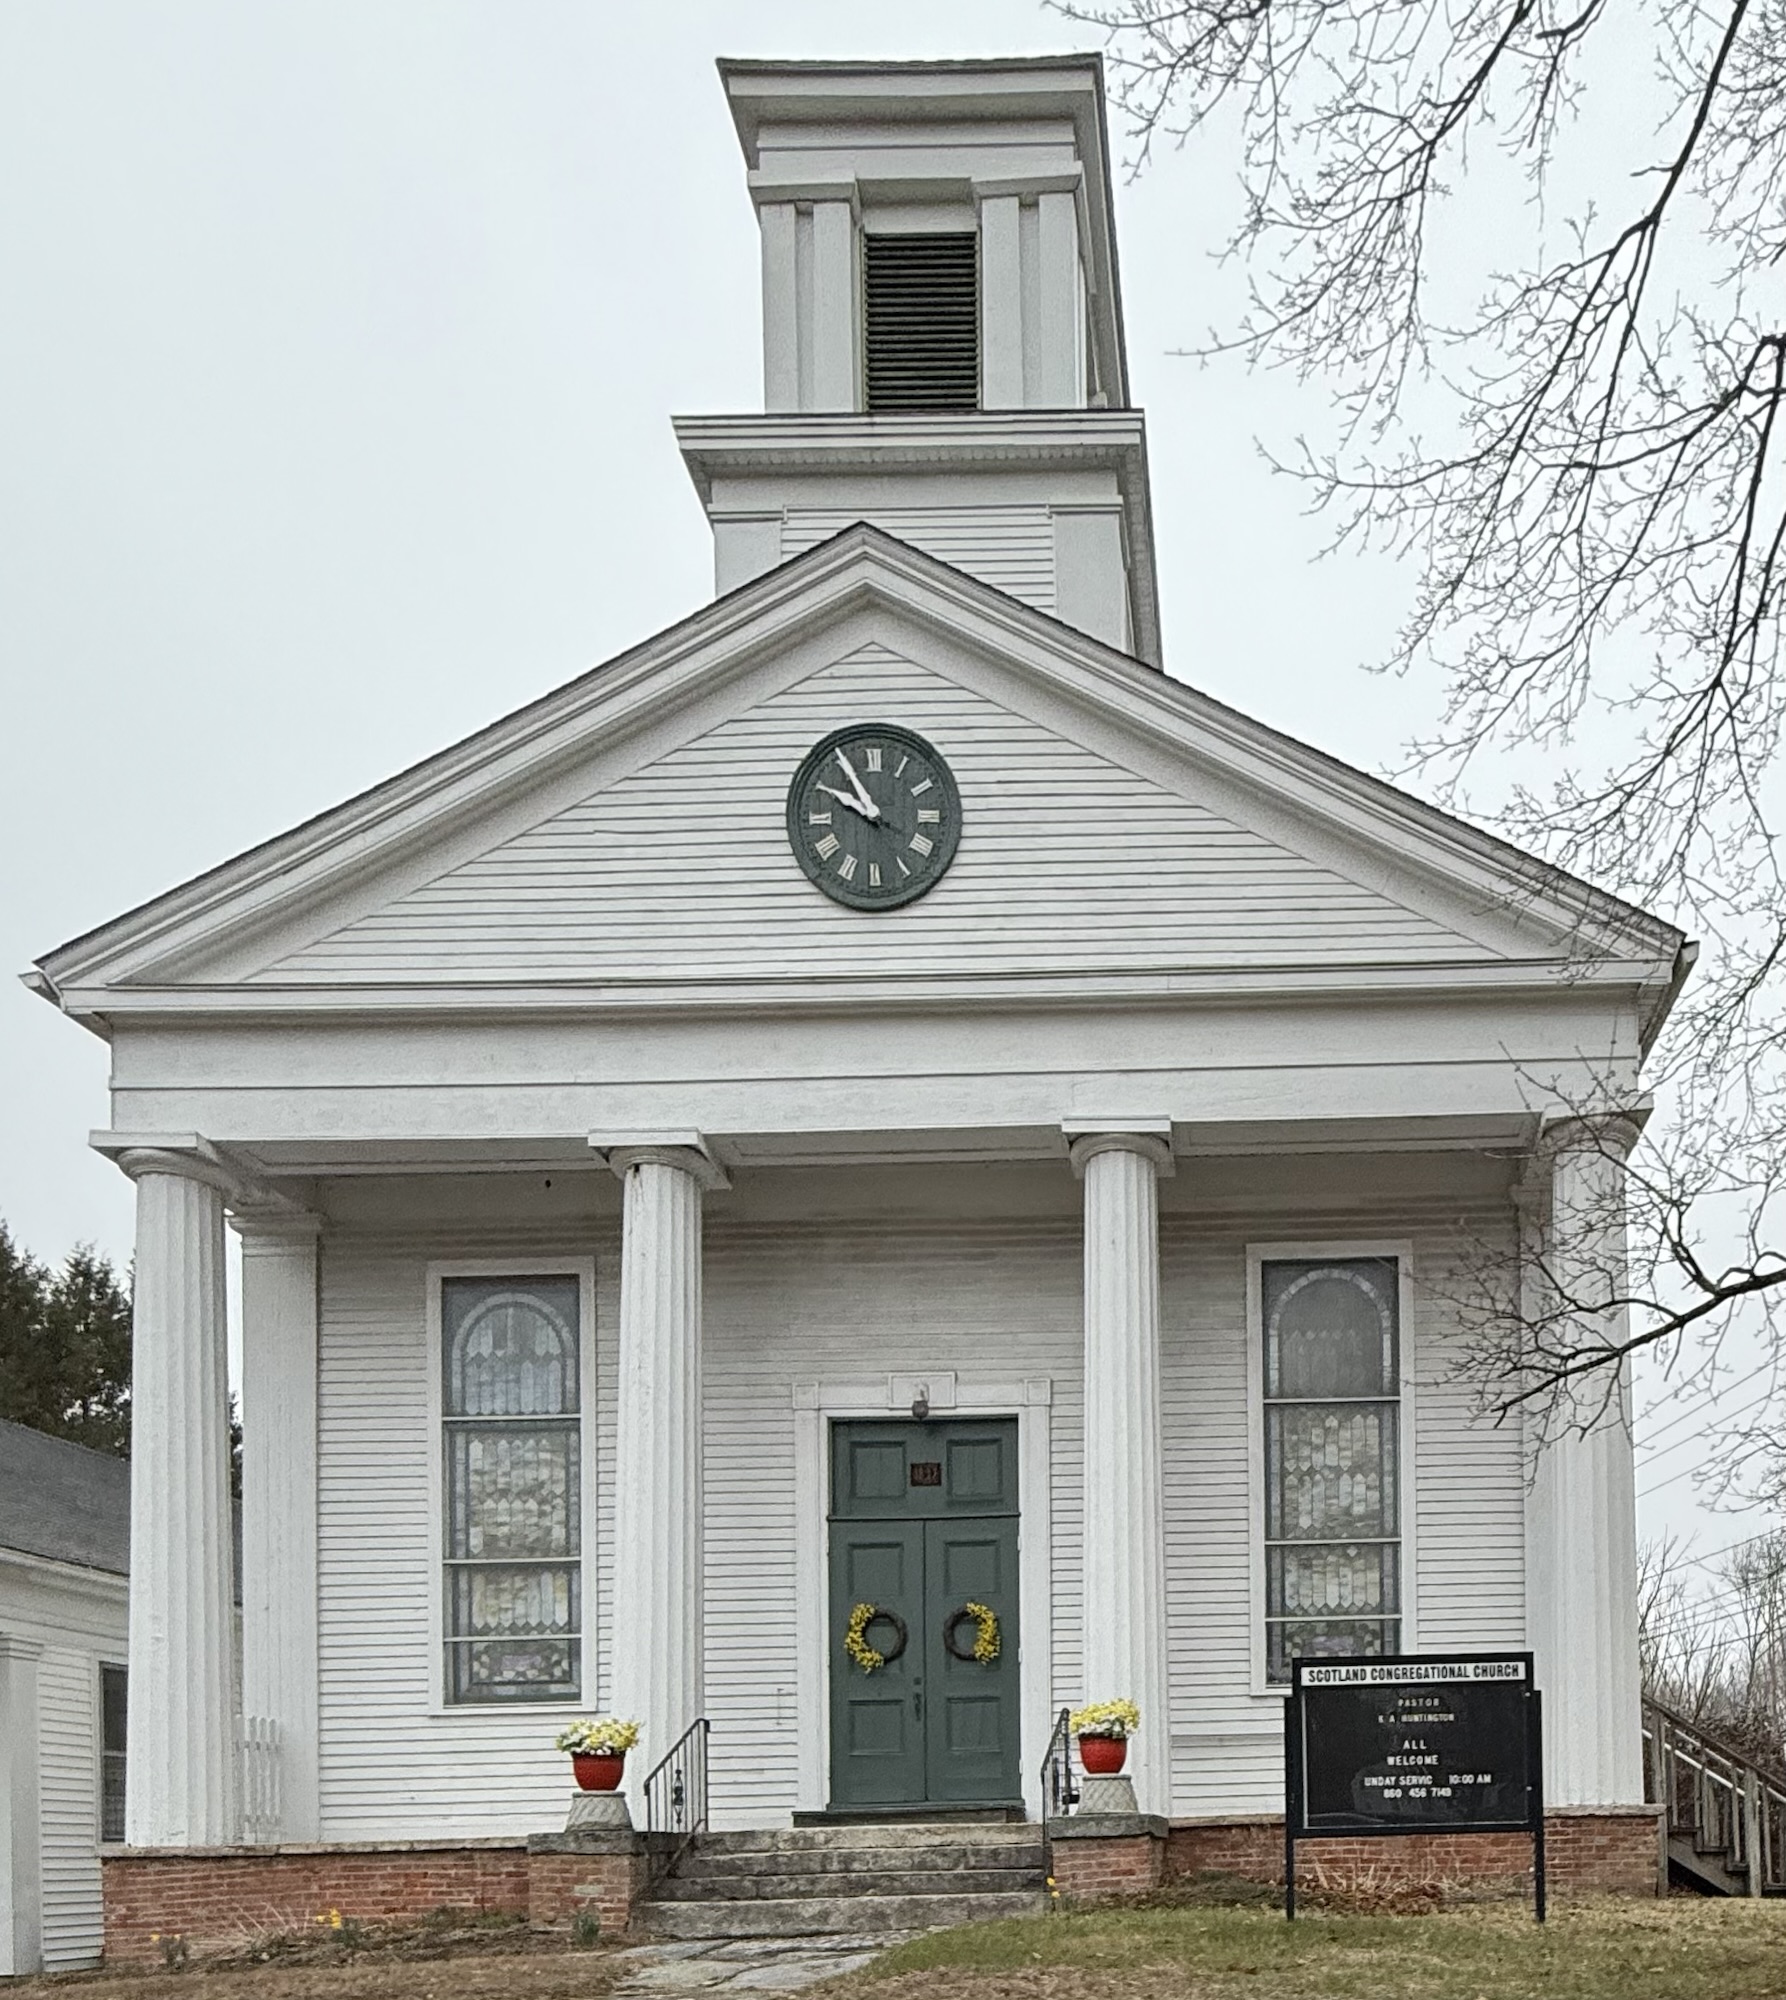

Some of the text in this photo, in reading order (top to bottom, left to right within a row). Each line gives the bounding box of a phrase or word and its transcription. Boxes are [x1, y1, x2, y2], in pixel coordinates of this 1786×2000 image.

[1308, 1663, 1519, 1683] SCOTLAND CONGREGATIONAL CHURCH
[1397, 1698, 1440, 1707] PASTOR
[1401, 1713, 1455, 1722] HUNTINGTON
[1403, 1739, 1427, 1750] ALL
[1386, 1755, 1439, 1766] WELCOME
[1364, 1773, 1492, 1786] UNDAY SERVIC 10:00 AM
[1408, 1788, 1427, 1798] 456
